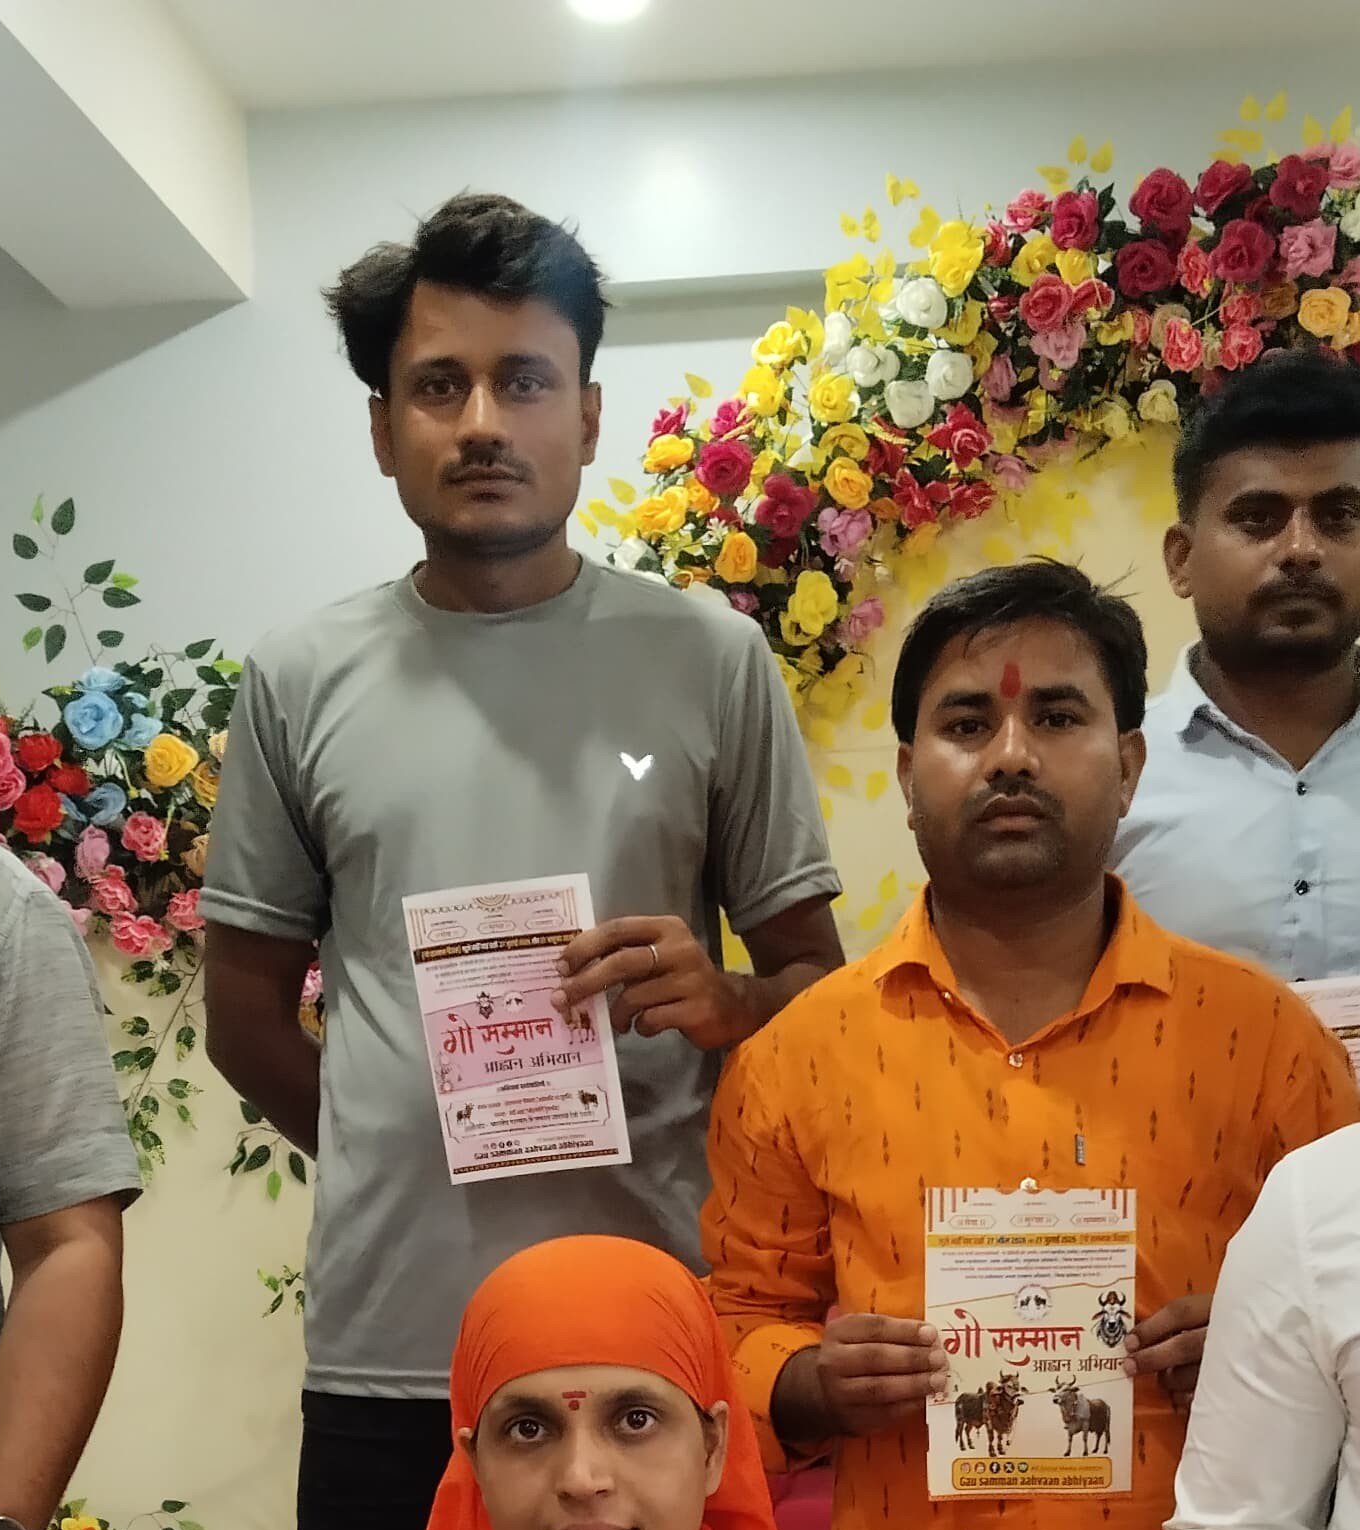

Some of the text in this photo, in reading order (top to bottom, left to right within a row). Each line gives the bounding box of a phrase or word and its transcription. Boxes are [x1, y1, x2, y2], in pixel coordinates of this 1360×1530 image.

[476, 1017, 555, 1056] सम्मान
[530, 1050, 582, 1069] अभियान
[987, 1326, 1086, 1367] सम्मान
